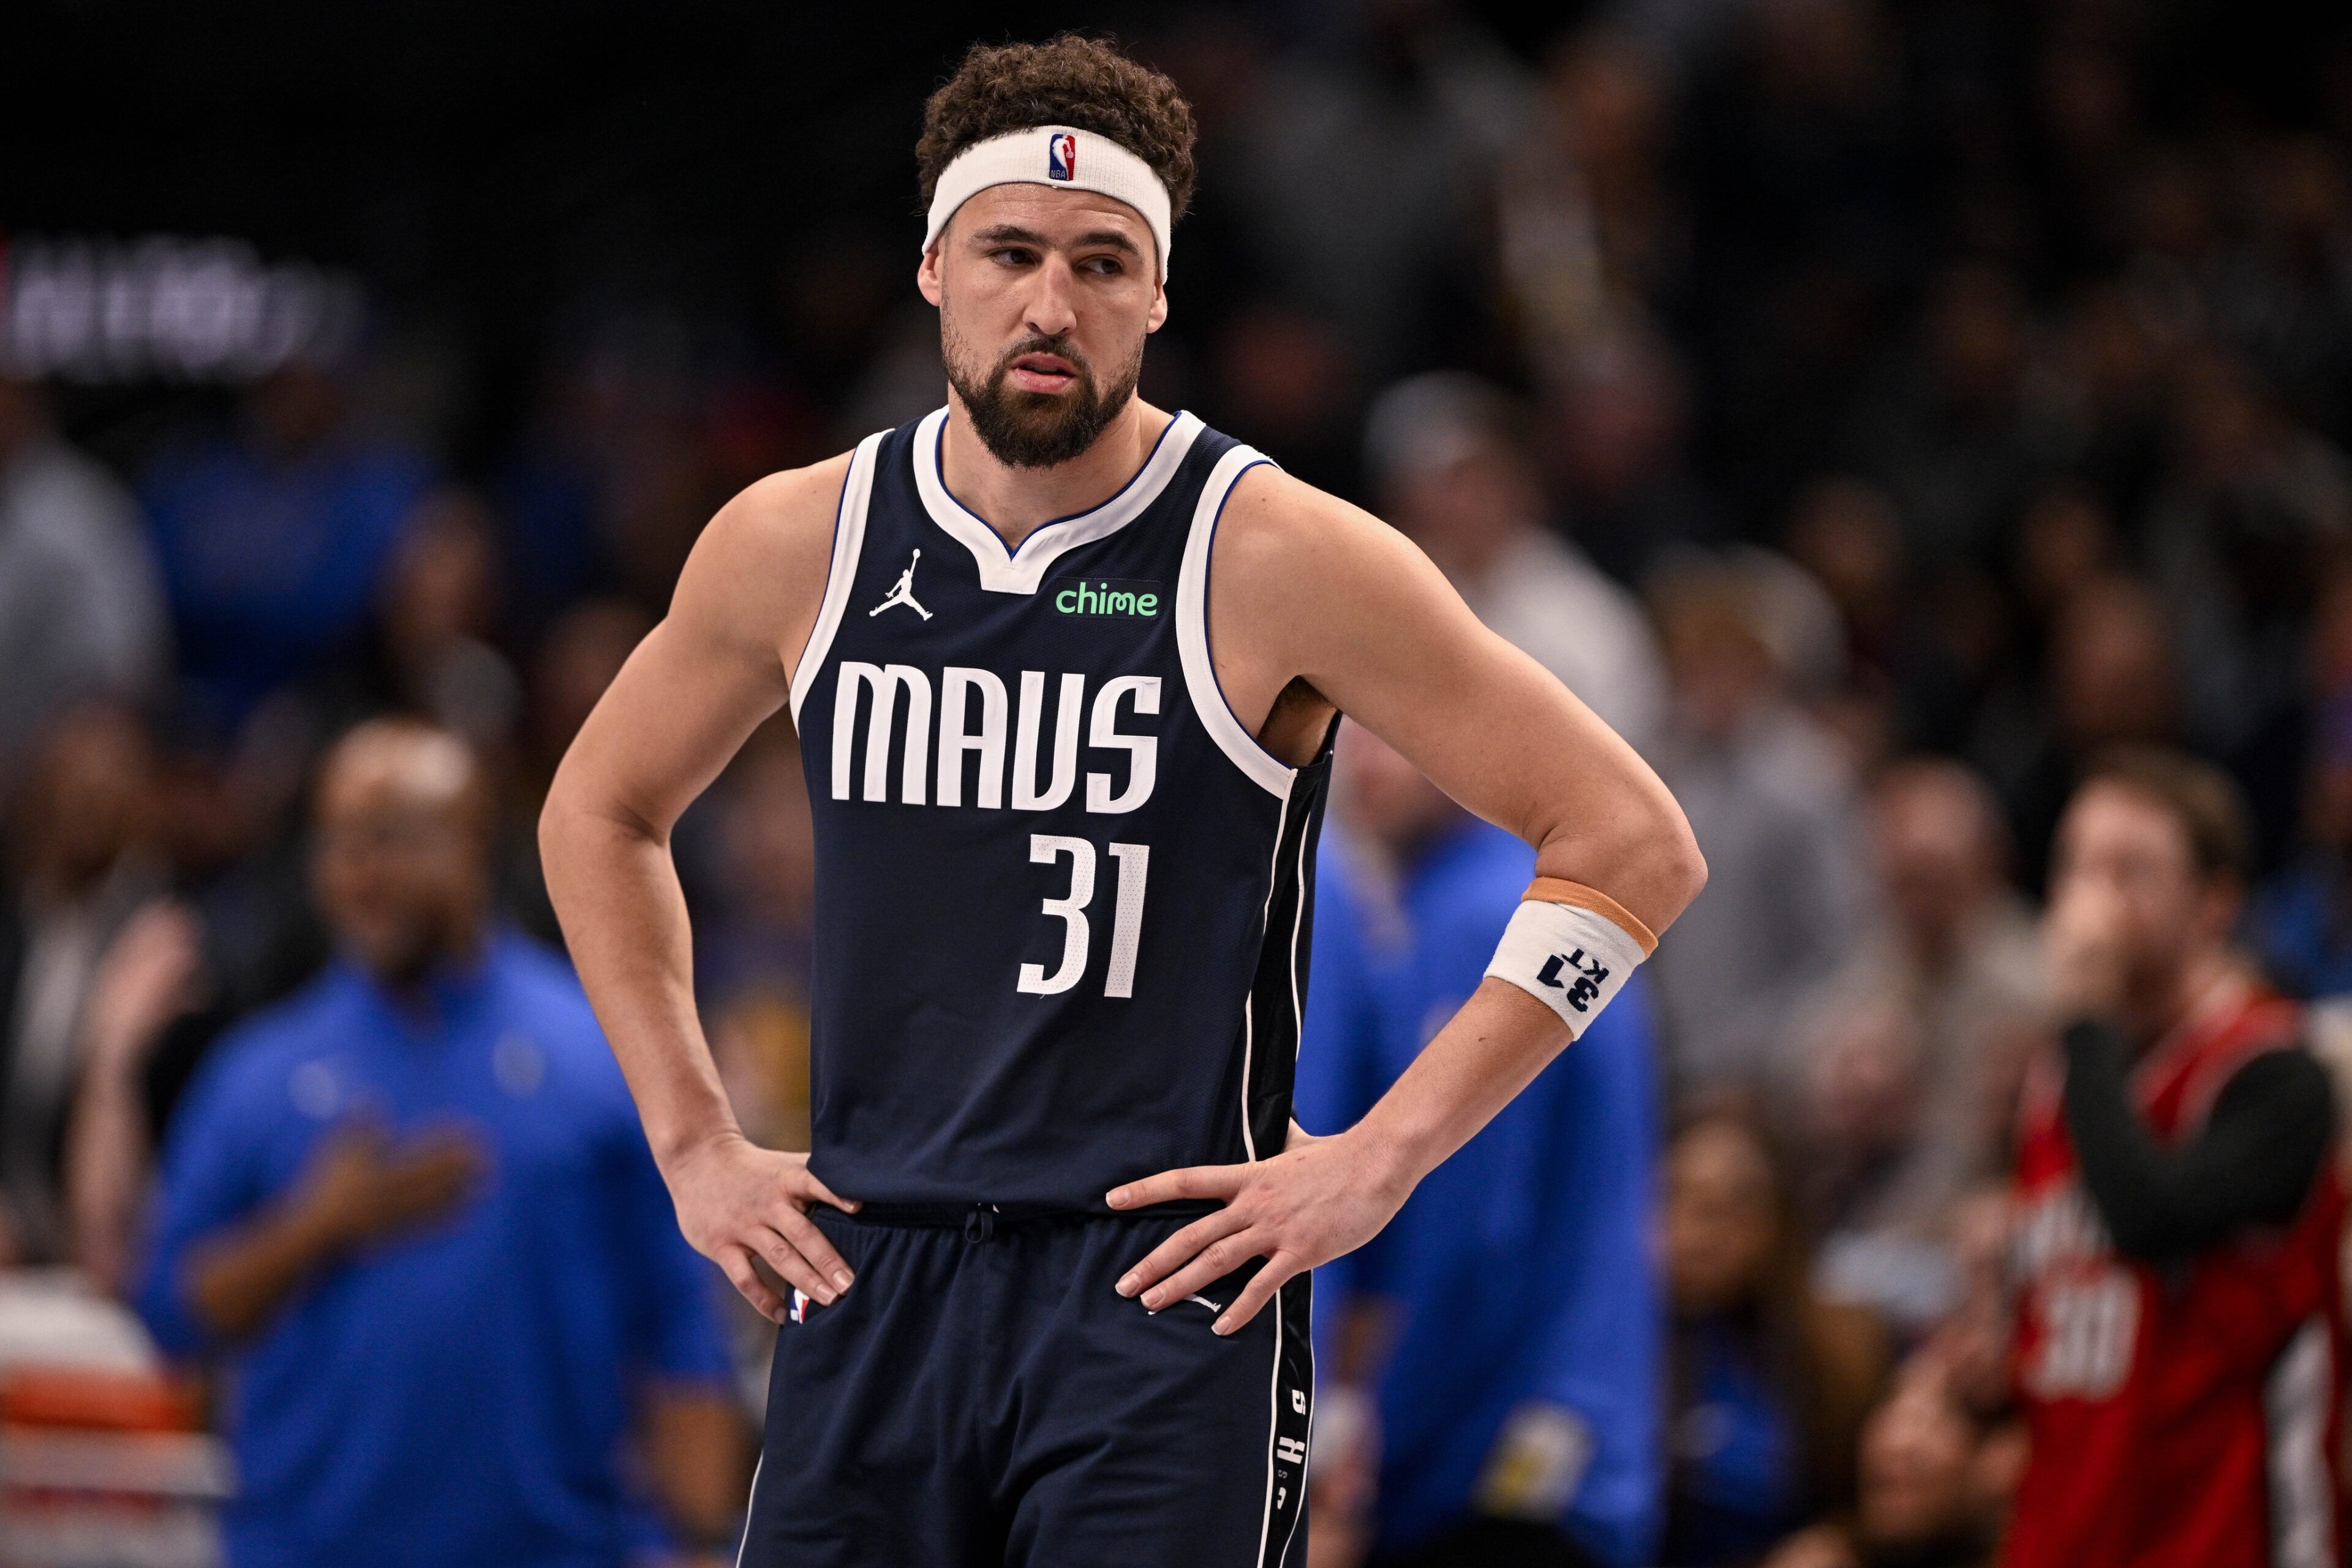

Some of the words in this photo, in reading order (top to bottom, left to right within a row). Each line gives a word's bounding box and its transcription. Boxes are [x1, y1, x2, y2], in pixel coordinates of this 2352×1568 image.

[1050, 170, 1066, 178] NBA
[1056, 582, 1158, 617] chime
[832, 661, 1162, 814] MAVS
[1017, 834, 1150, 998] 31
[1536, 954, 1599, 1012] 31
[1561, 948, 1610, 984] KT
